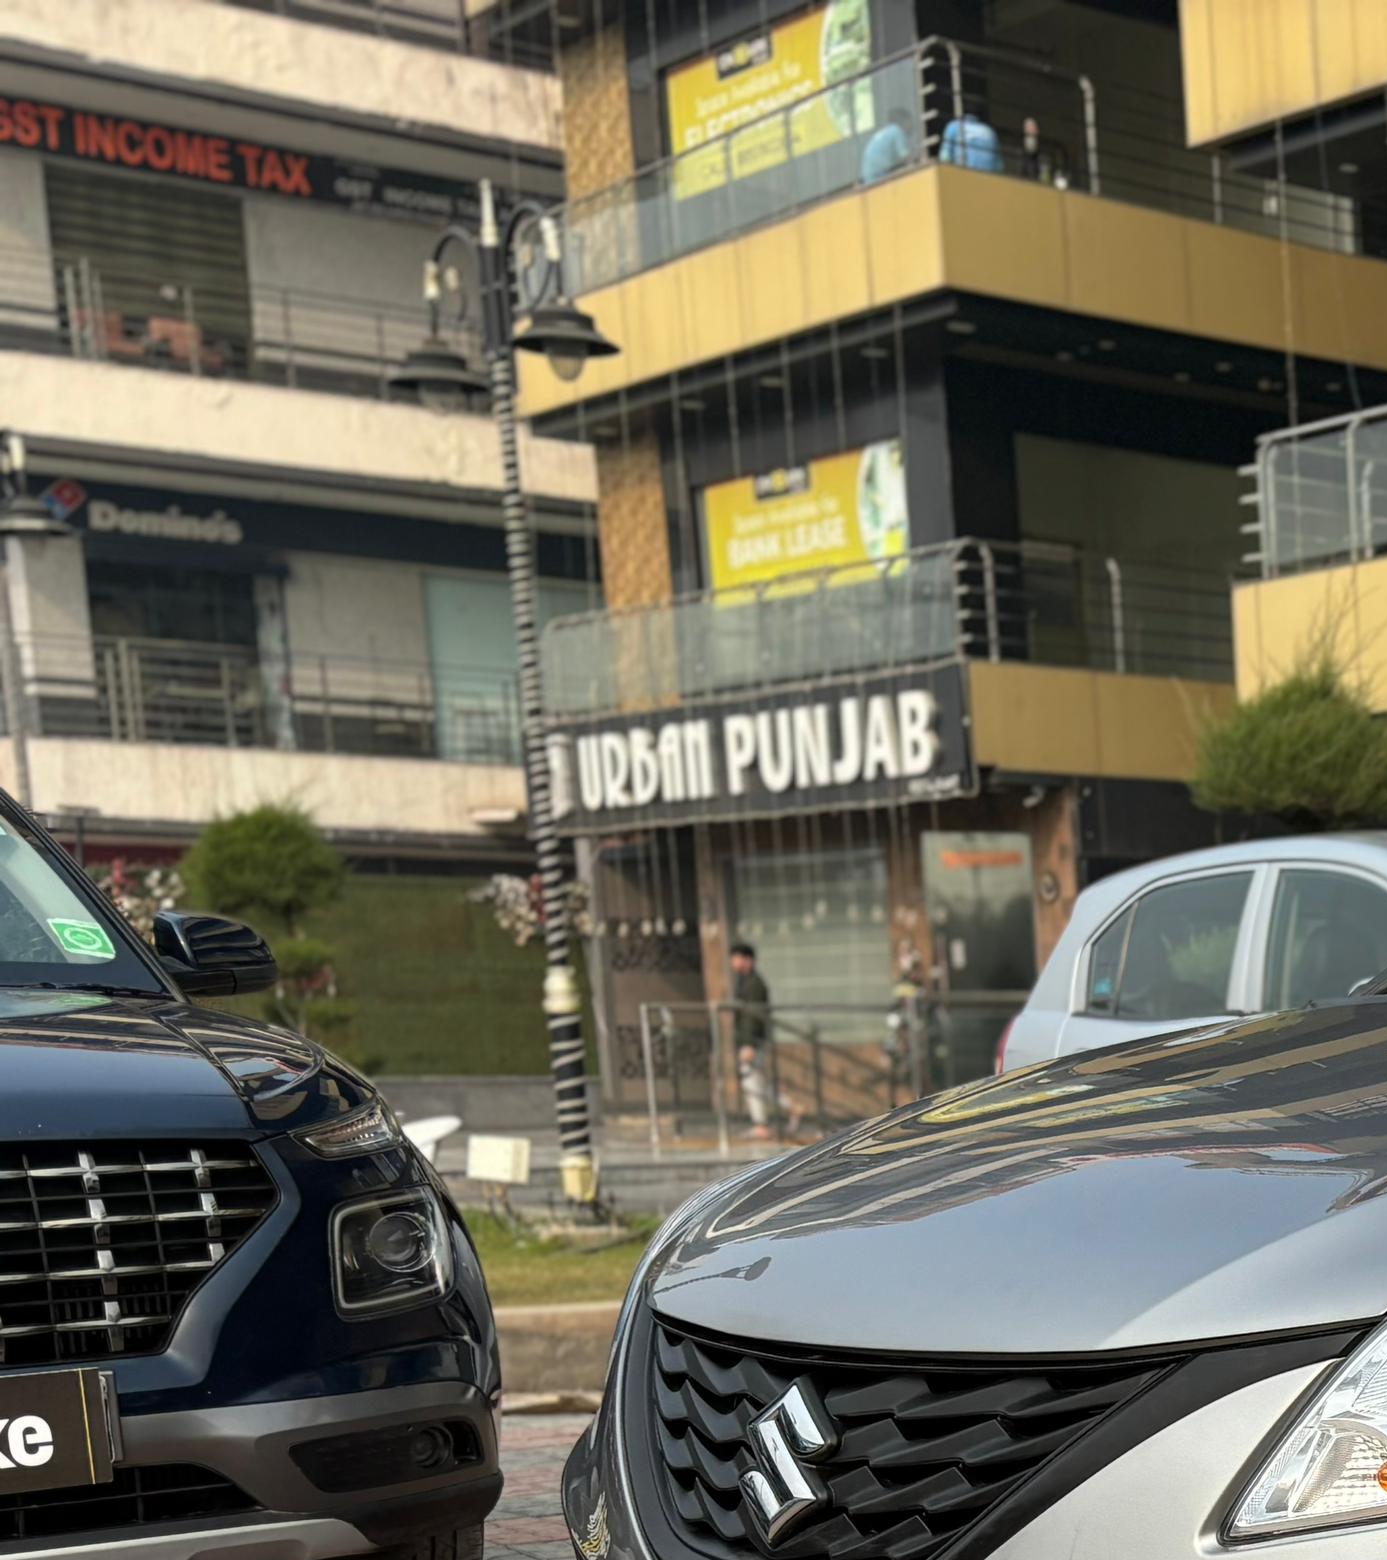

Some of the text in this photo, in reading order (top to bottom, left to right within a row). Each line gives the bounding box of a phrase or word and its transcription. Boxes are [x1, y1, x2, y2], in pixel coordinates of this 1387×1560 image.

[73, 110, 234, 183] INCOME
[236, 145, 312, 197] TAX
[784, 515, 847, 558] LEASE
[576, 689, 939, 811] URBAN PUNJAB
